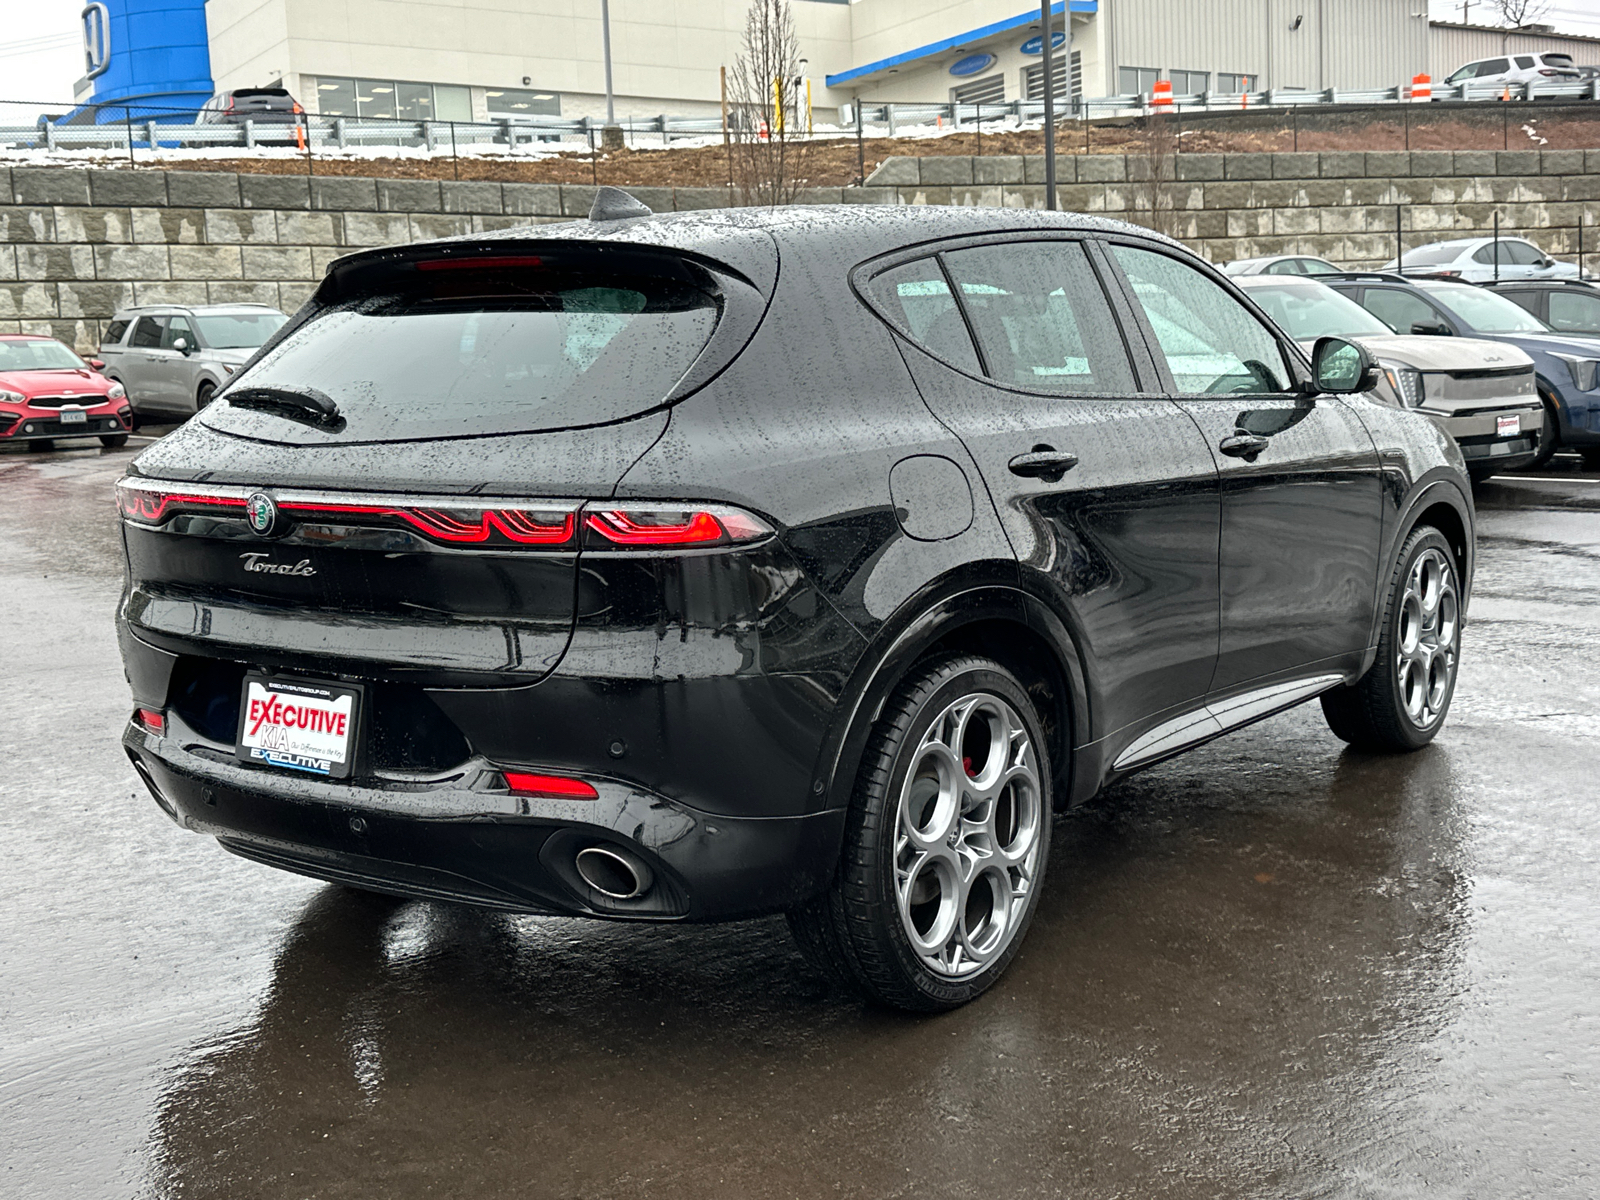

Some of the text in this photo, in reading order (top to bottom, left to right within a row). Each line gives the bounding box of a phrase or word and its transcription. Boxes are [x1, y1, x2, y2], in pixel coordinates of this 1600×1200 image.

[239, 552, 317, 576] Tonale
[249, 694, 346, 736] EXECUTIVE
[260, 725, 290, 752] KIA
[250, 748, 331, 771] EXECUTIVE
